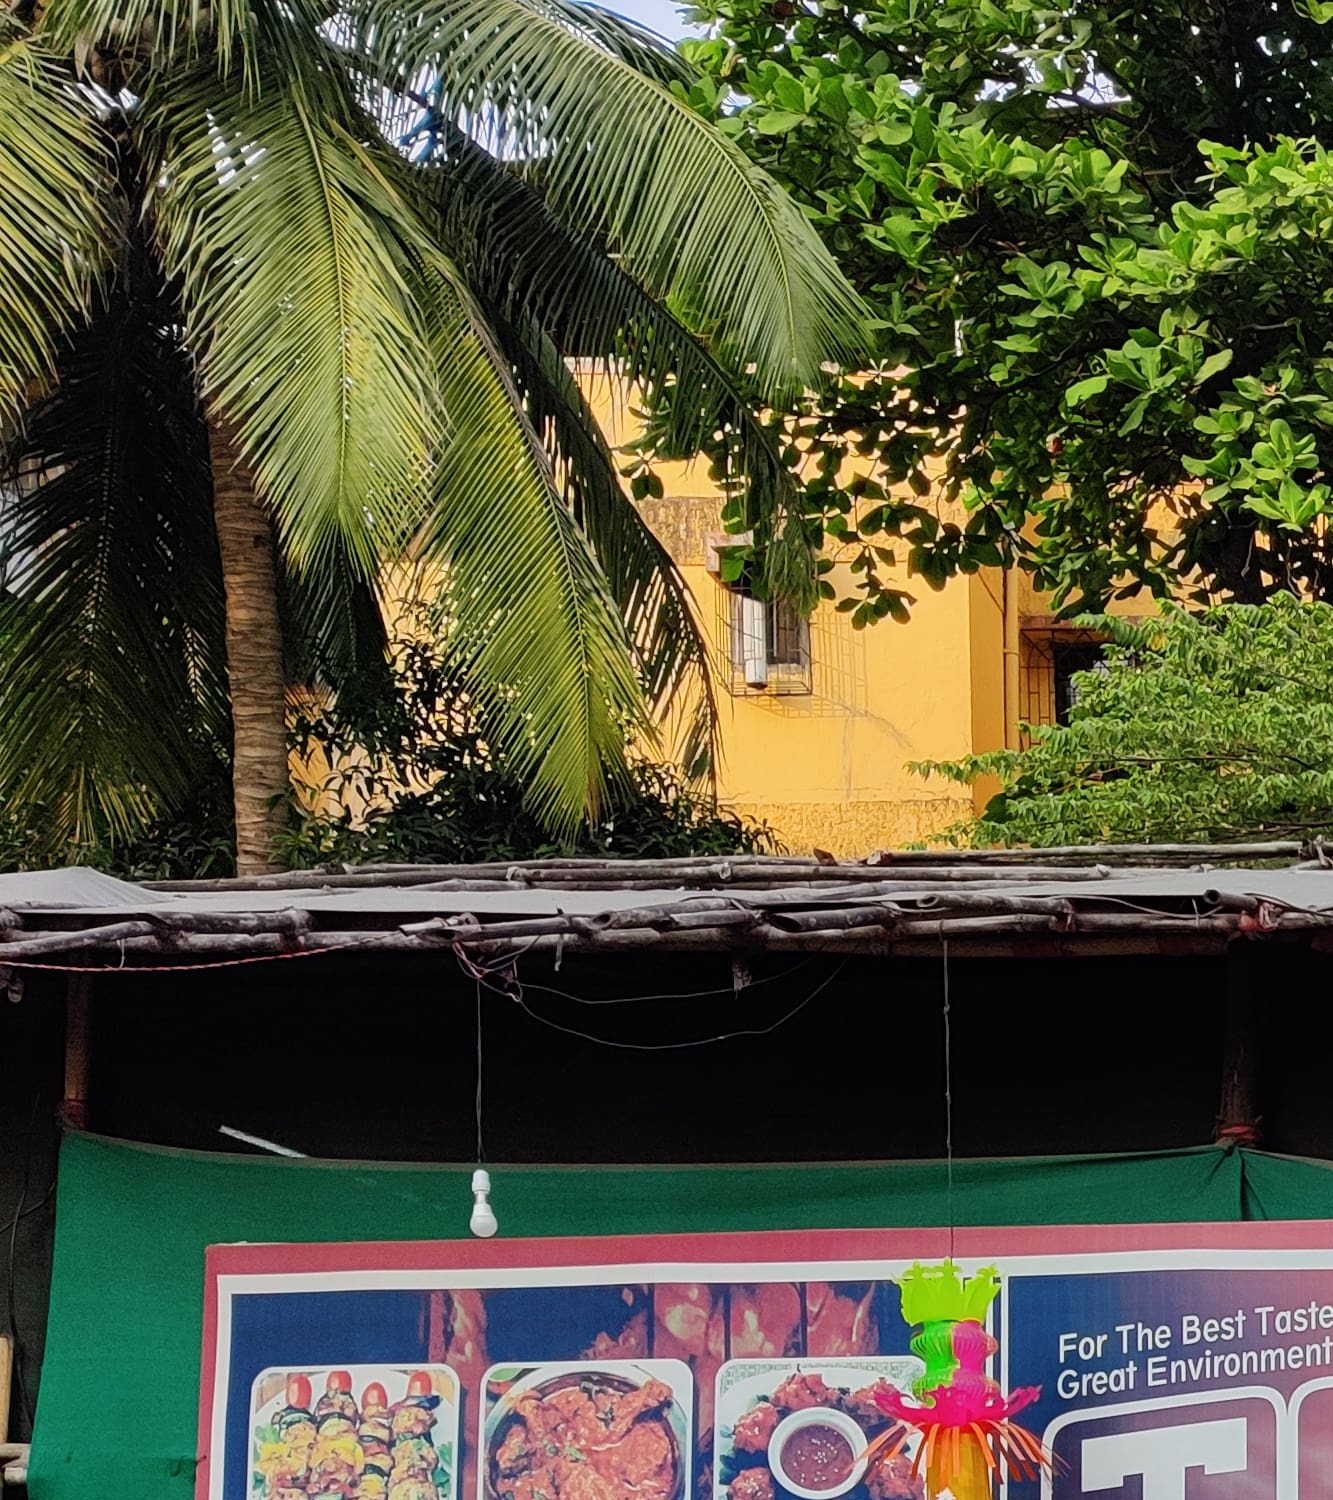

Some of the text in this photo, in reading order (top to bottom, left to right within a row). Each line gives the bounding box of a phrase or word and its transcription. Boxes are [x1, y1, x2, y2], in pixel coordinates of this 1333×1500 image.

[1059, 1333, 1107, 1364] For
[1115, 1322, 1172, 1354] The
[1182, 1309, 1246, 1346] Best
[1057, 1360, 1138, 1400] Great
[1147, 1335, 1333, 1388] Environment
